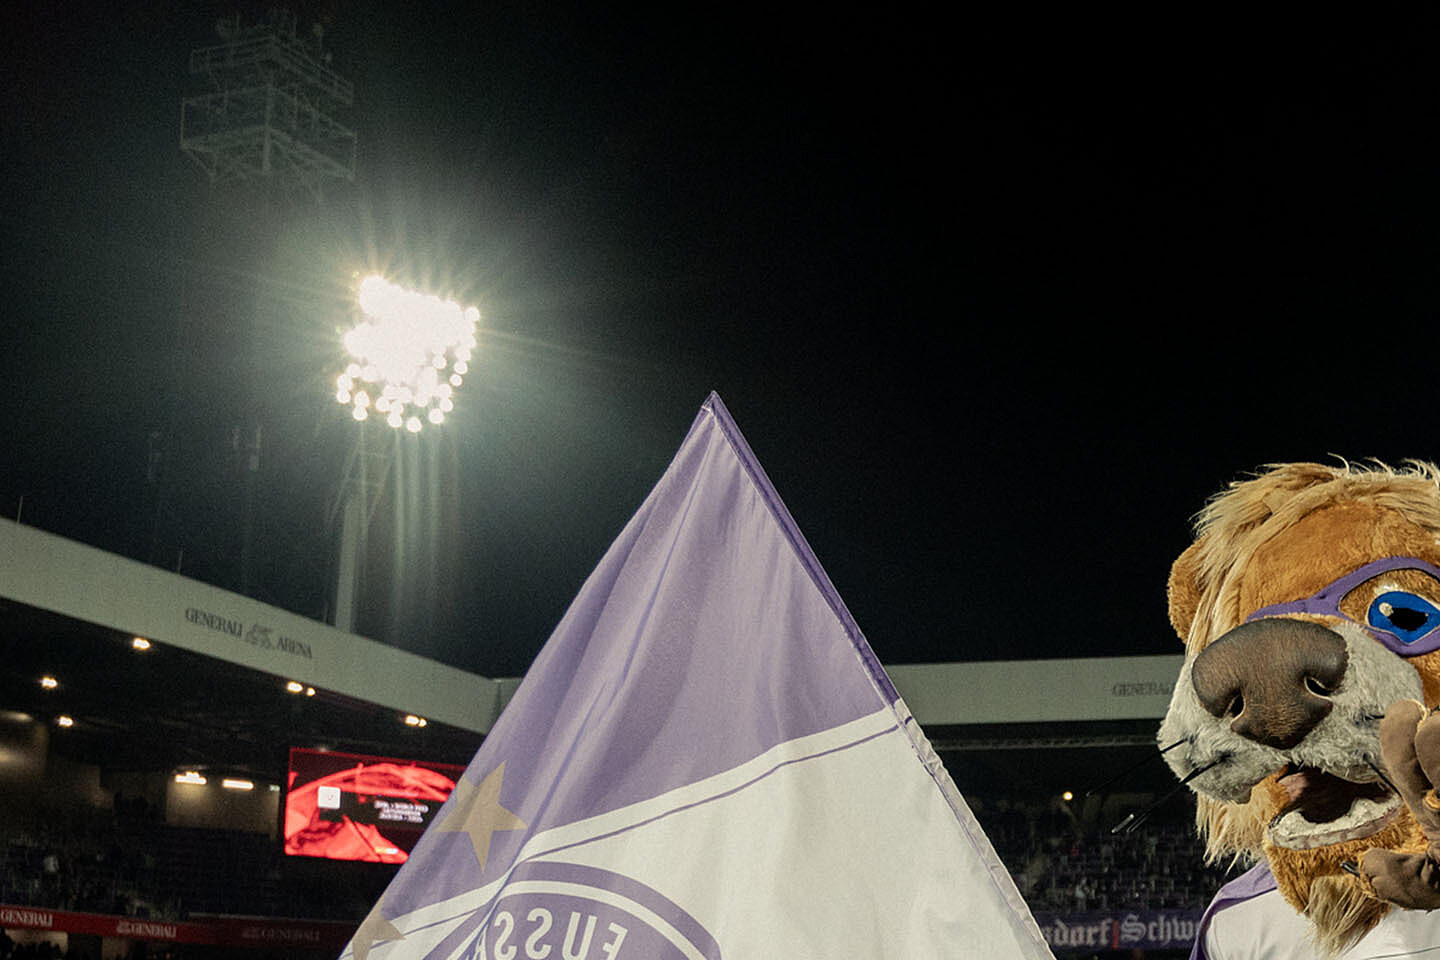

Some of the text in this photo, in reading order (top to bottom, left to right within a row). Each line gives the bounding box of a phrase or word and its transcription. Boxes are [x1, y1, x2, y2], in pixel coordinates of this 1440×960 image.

[0, 909, 53, 928] GENERALI
[130, 923, 177, 939] GENERALI
[1121, 913, 1199, 946] Schw
